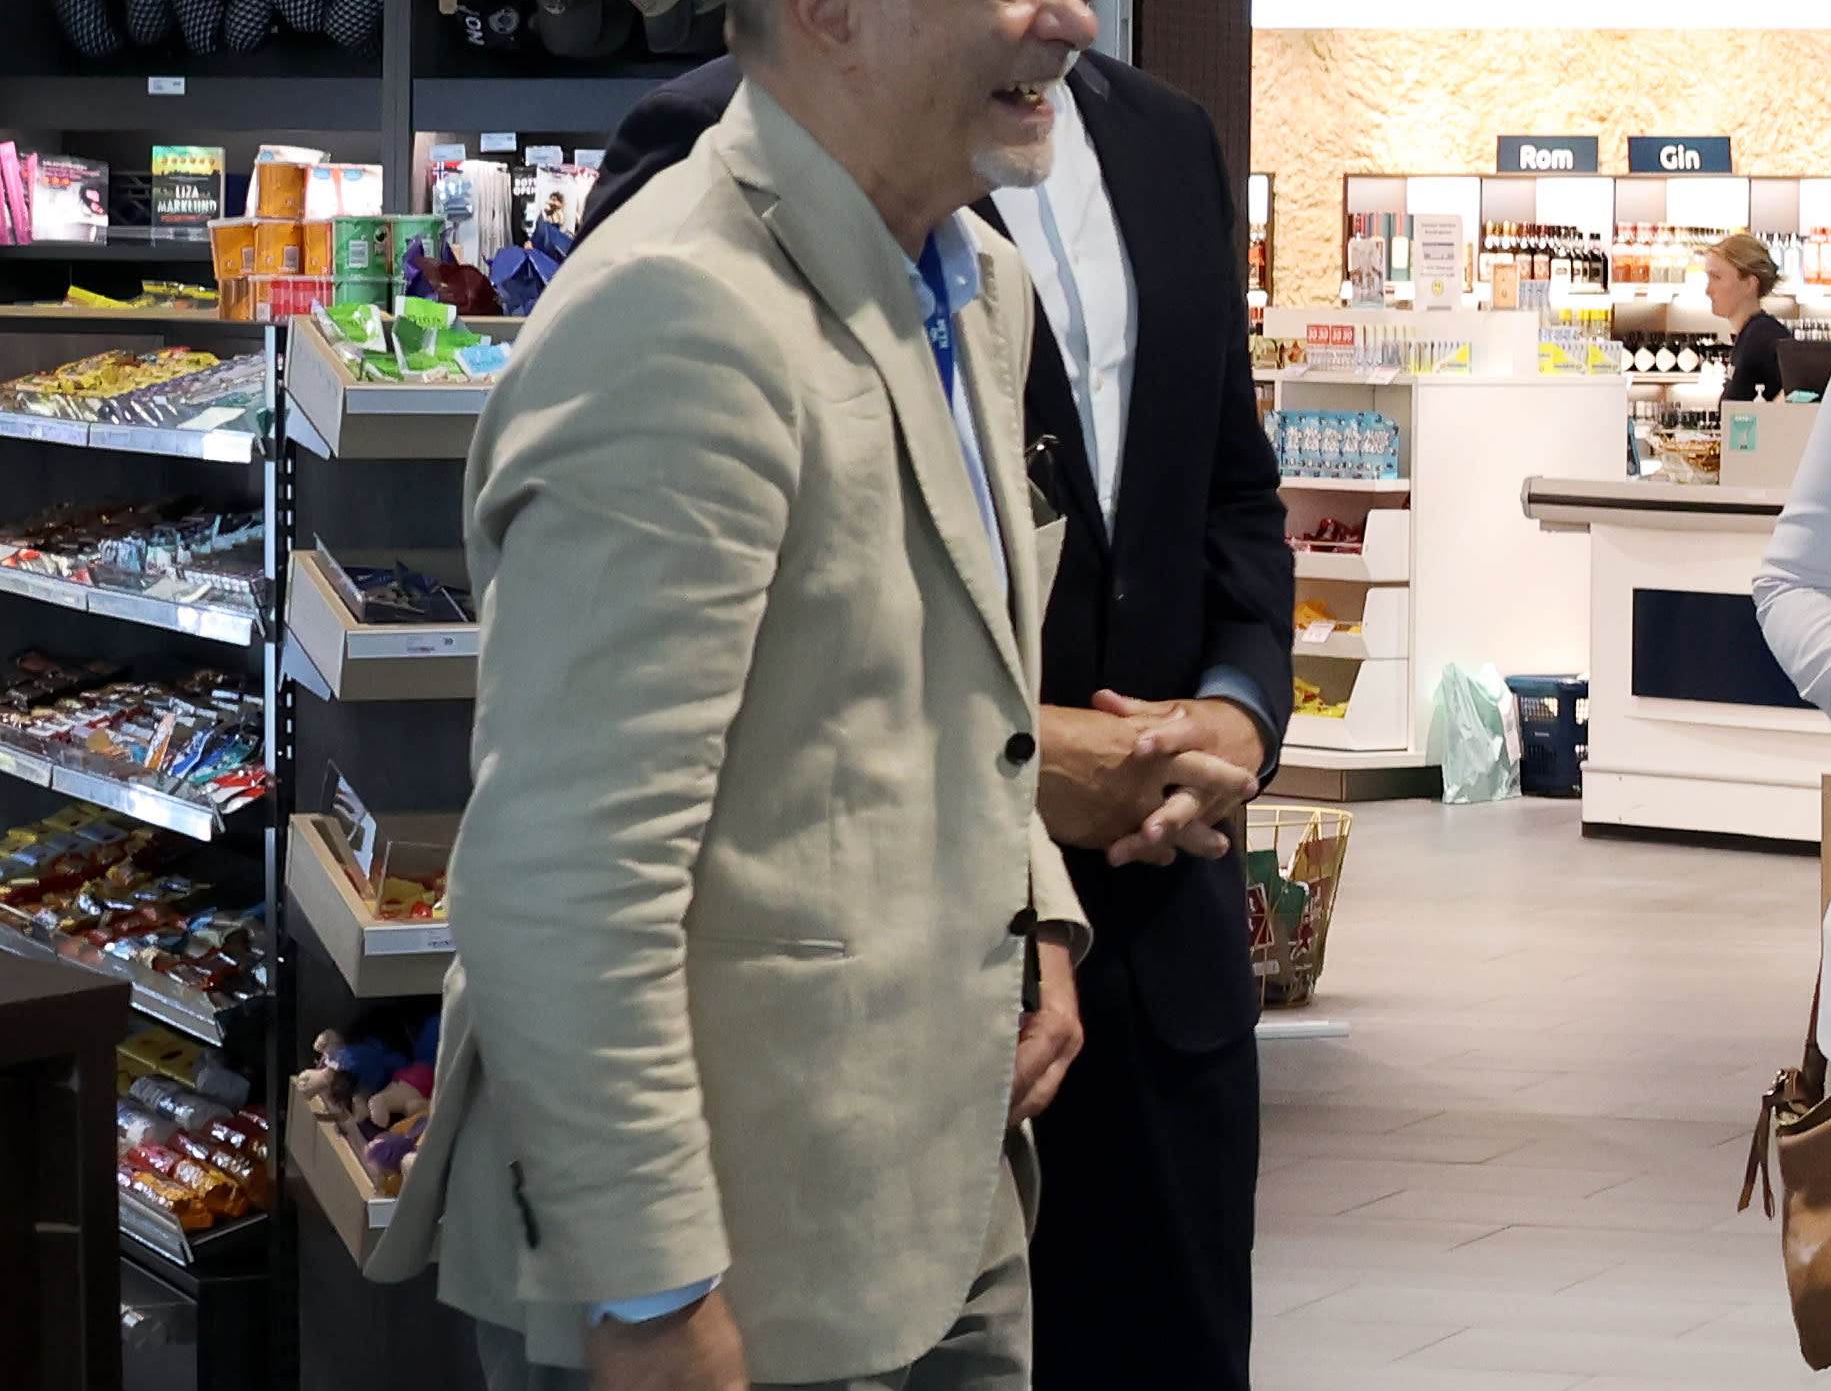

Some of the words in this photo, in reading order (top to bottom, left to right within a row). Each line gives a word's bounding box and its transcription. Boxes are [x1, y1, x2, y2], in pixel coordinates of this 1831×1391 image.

[1519, 144, 1574, 170] Rom
[1659, 143, 1701, 170] Gin
[175, 184, 199, 199] LIZA
[157, 199, 217, 213] MARKLUND
